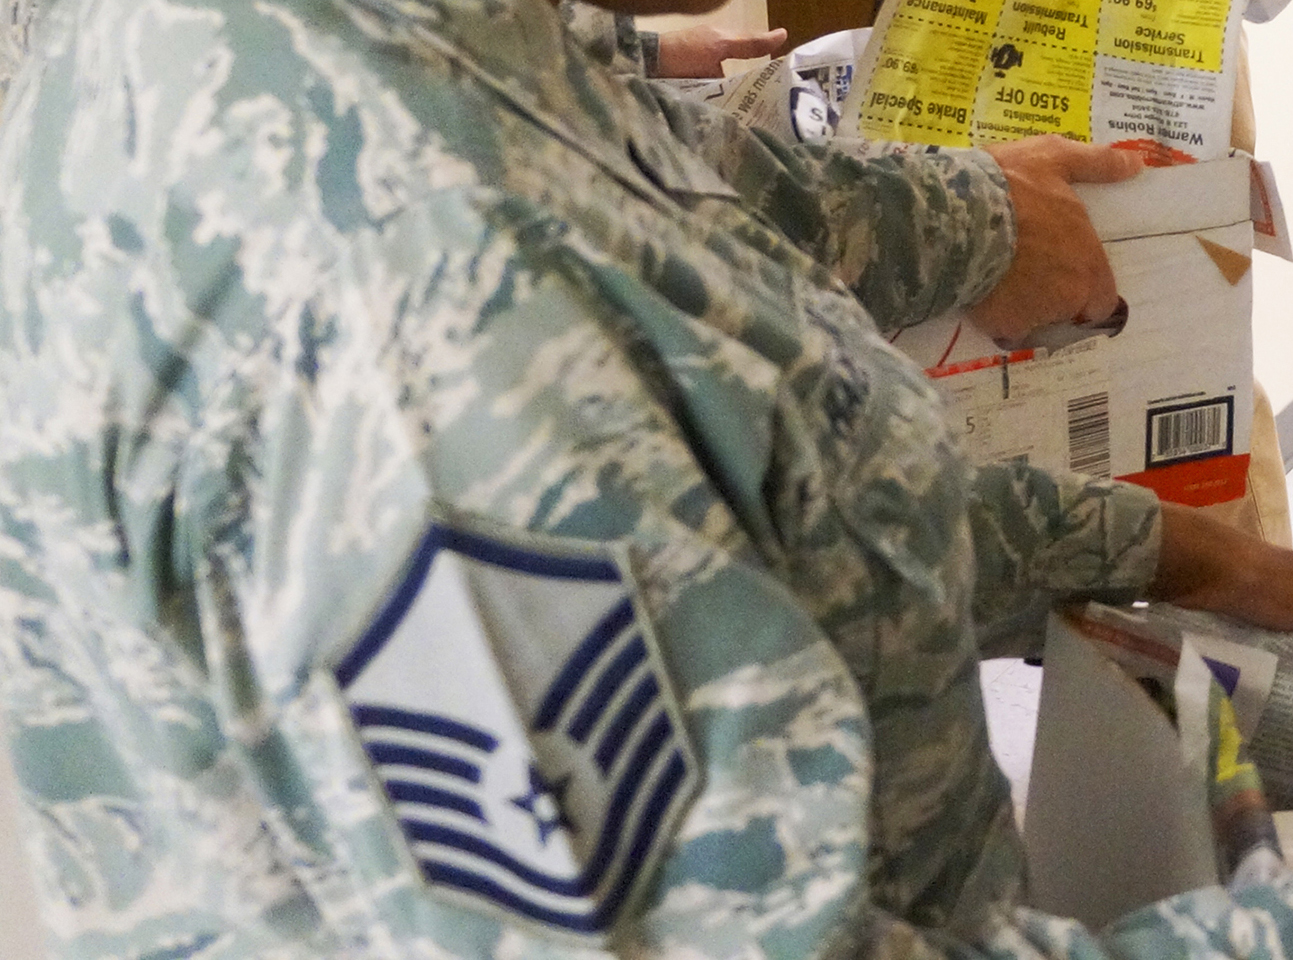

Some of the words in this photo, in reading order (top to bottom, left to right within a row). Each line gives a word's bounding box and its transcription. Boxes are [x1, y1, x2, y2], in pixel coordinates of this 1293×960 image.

[1012, 1, 1089, 29] Transmission
[1022, 20, 1067, 41] Rebuilt
[1134, 26, 1186, 46] Service
[1113, 37, 1205, 64] Transmission
[737, 90, 758, 113] was
[869, 91, 924, 117] Special
[995, 85, 1025, 106] OFF
[1030, 91, 1070, 113] $150
[926, 101, 967, 125] Brake
[1003, 108, 1062, 128] Specialists
[1108, 119, 1155, 138] Robins
